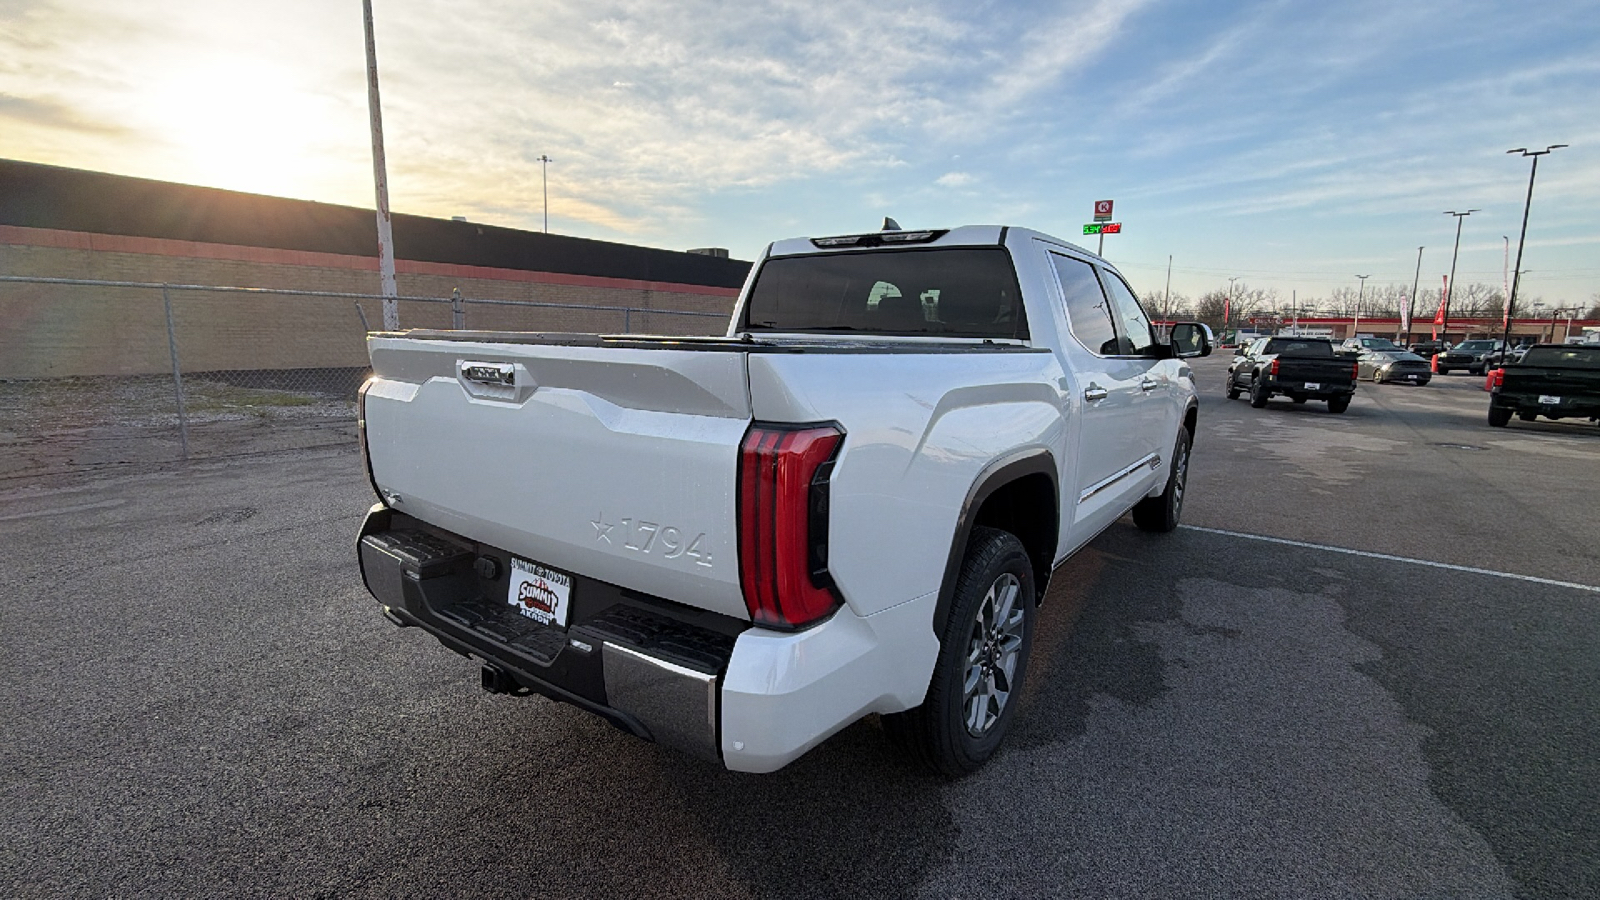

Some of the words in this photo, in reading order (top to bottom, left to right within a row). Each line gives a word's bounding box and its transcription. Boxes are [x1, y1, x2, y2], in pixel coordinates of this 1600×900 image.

[621, 517, 713, 568] 1794
[511, 557, 537, 575] SUMMIT
[545, 568, 571, 588] TOYOTA
[519, 582, 558, 613] SUMMIT
